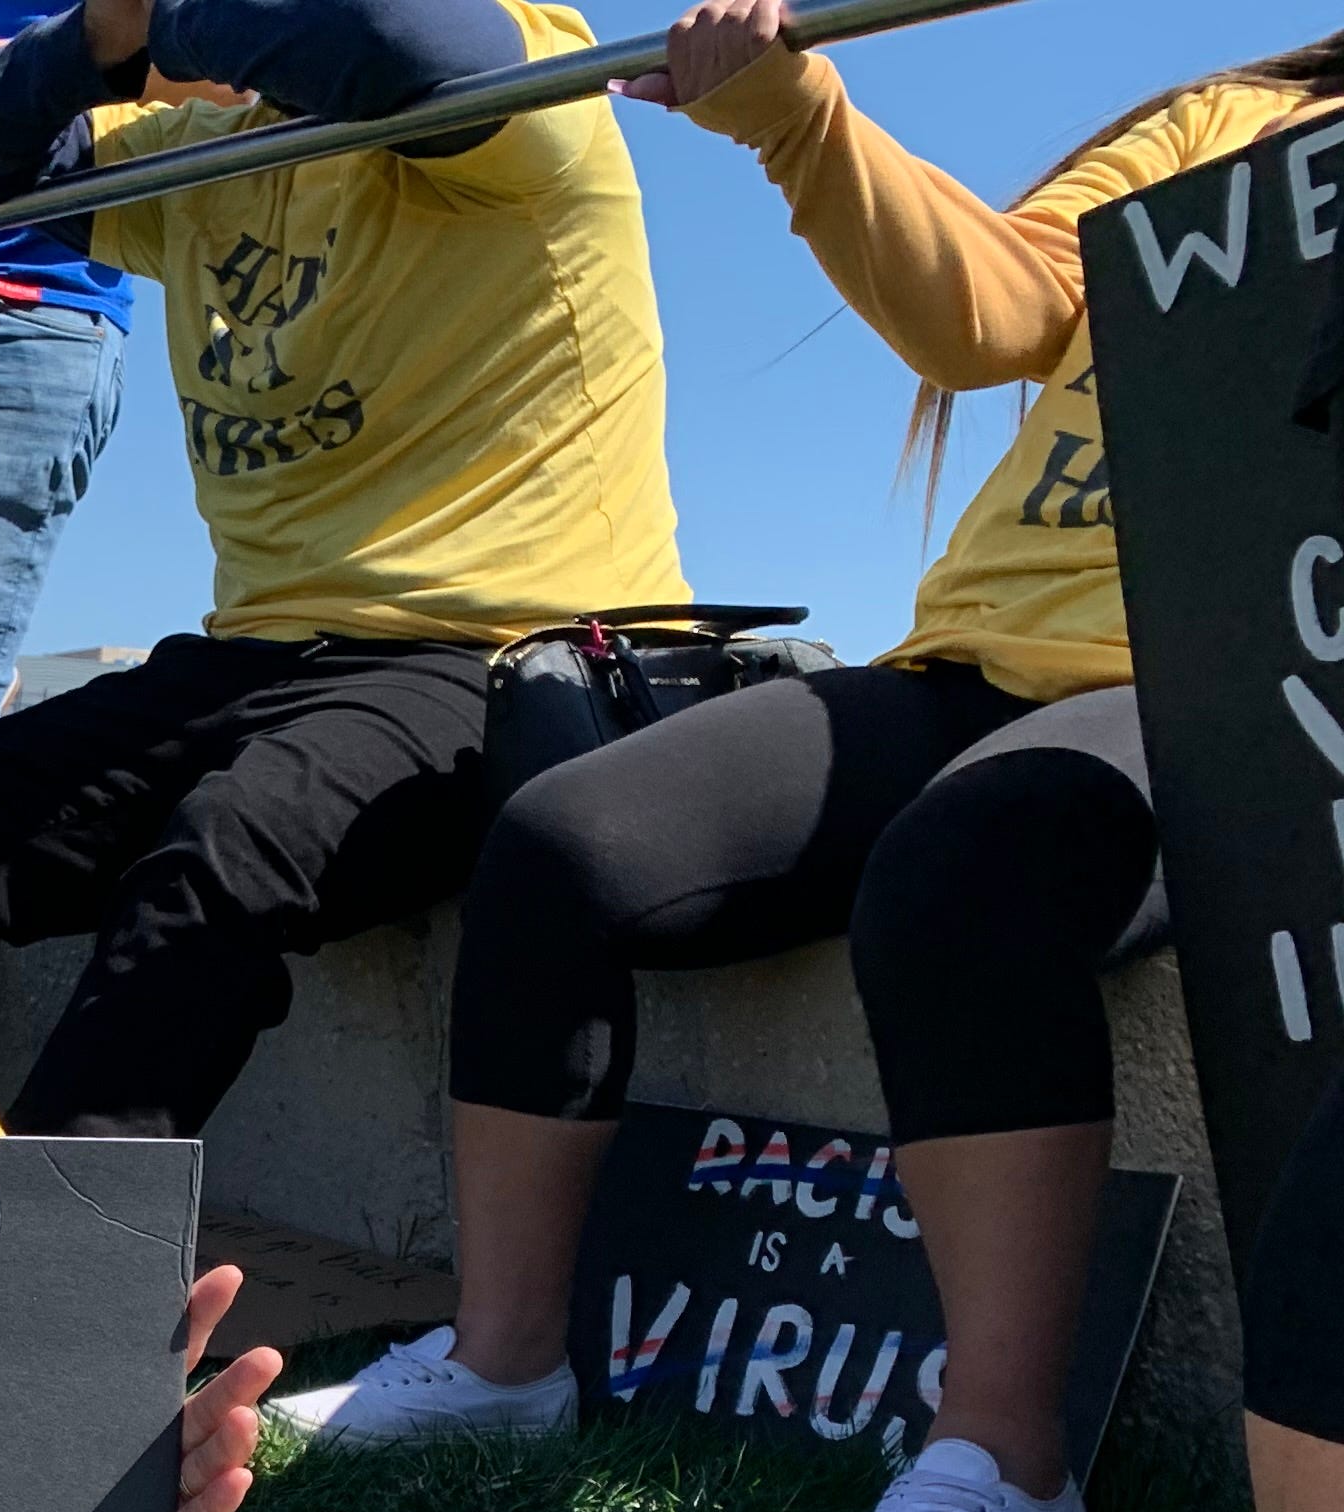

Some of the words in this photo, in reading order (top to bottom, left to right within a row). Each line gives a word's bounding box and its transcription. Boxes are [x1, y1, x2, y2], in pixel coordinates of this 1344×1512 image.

[1123, 119, 1344, 312] WE
[688, 1118, 923, 1239] RACI
[748, 1231, 787, 1272] IS
[820, 1242, 855, 1278] A
